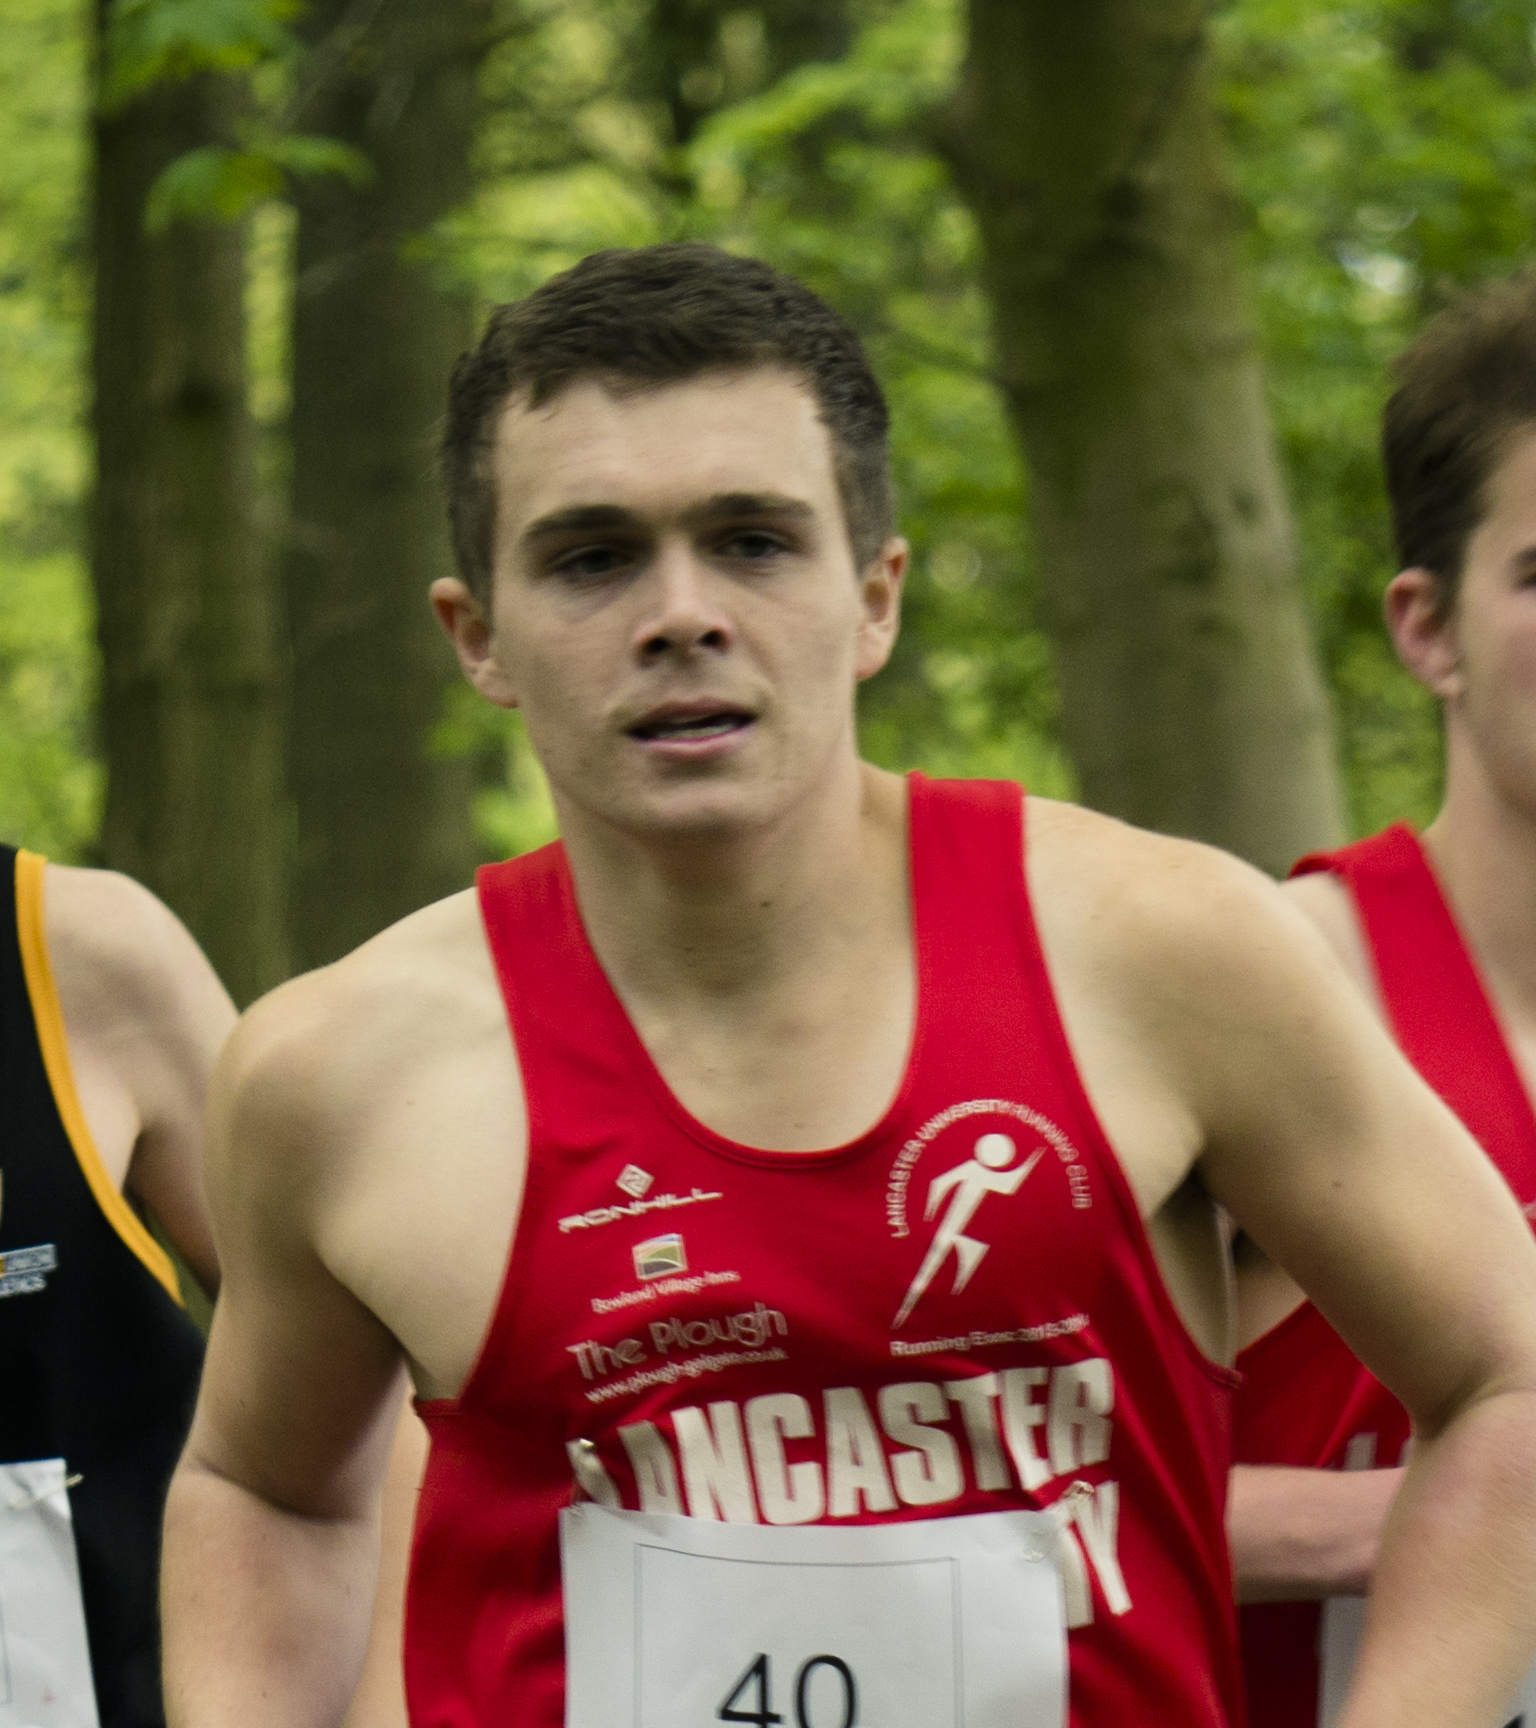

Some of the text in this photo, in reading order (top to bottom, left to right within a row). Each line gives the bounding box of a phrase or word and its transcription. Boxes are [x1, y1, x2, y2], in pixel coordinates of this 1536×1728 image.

[885, 1098, 1093, 1238] LANCASTER UNIVERSITY RUNNING CLUB
[566, 1301, 789, 1380] The Plough
[889, 1335, 971, 1356] Running
